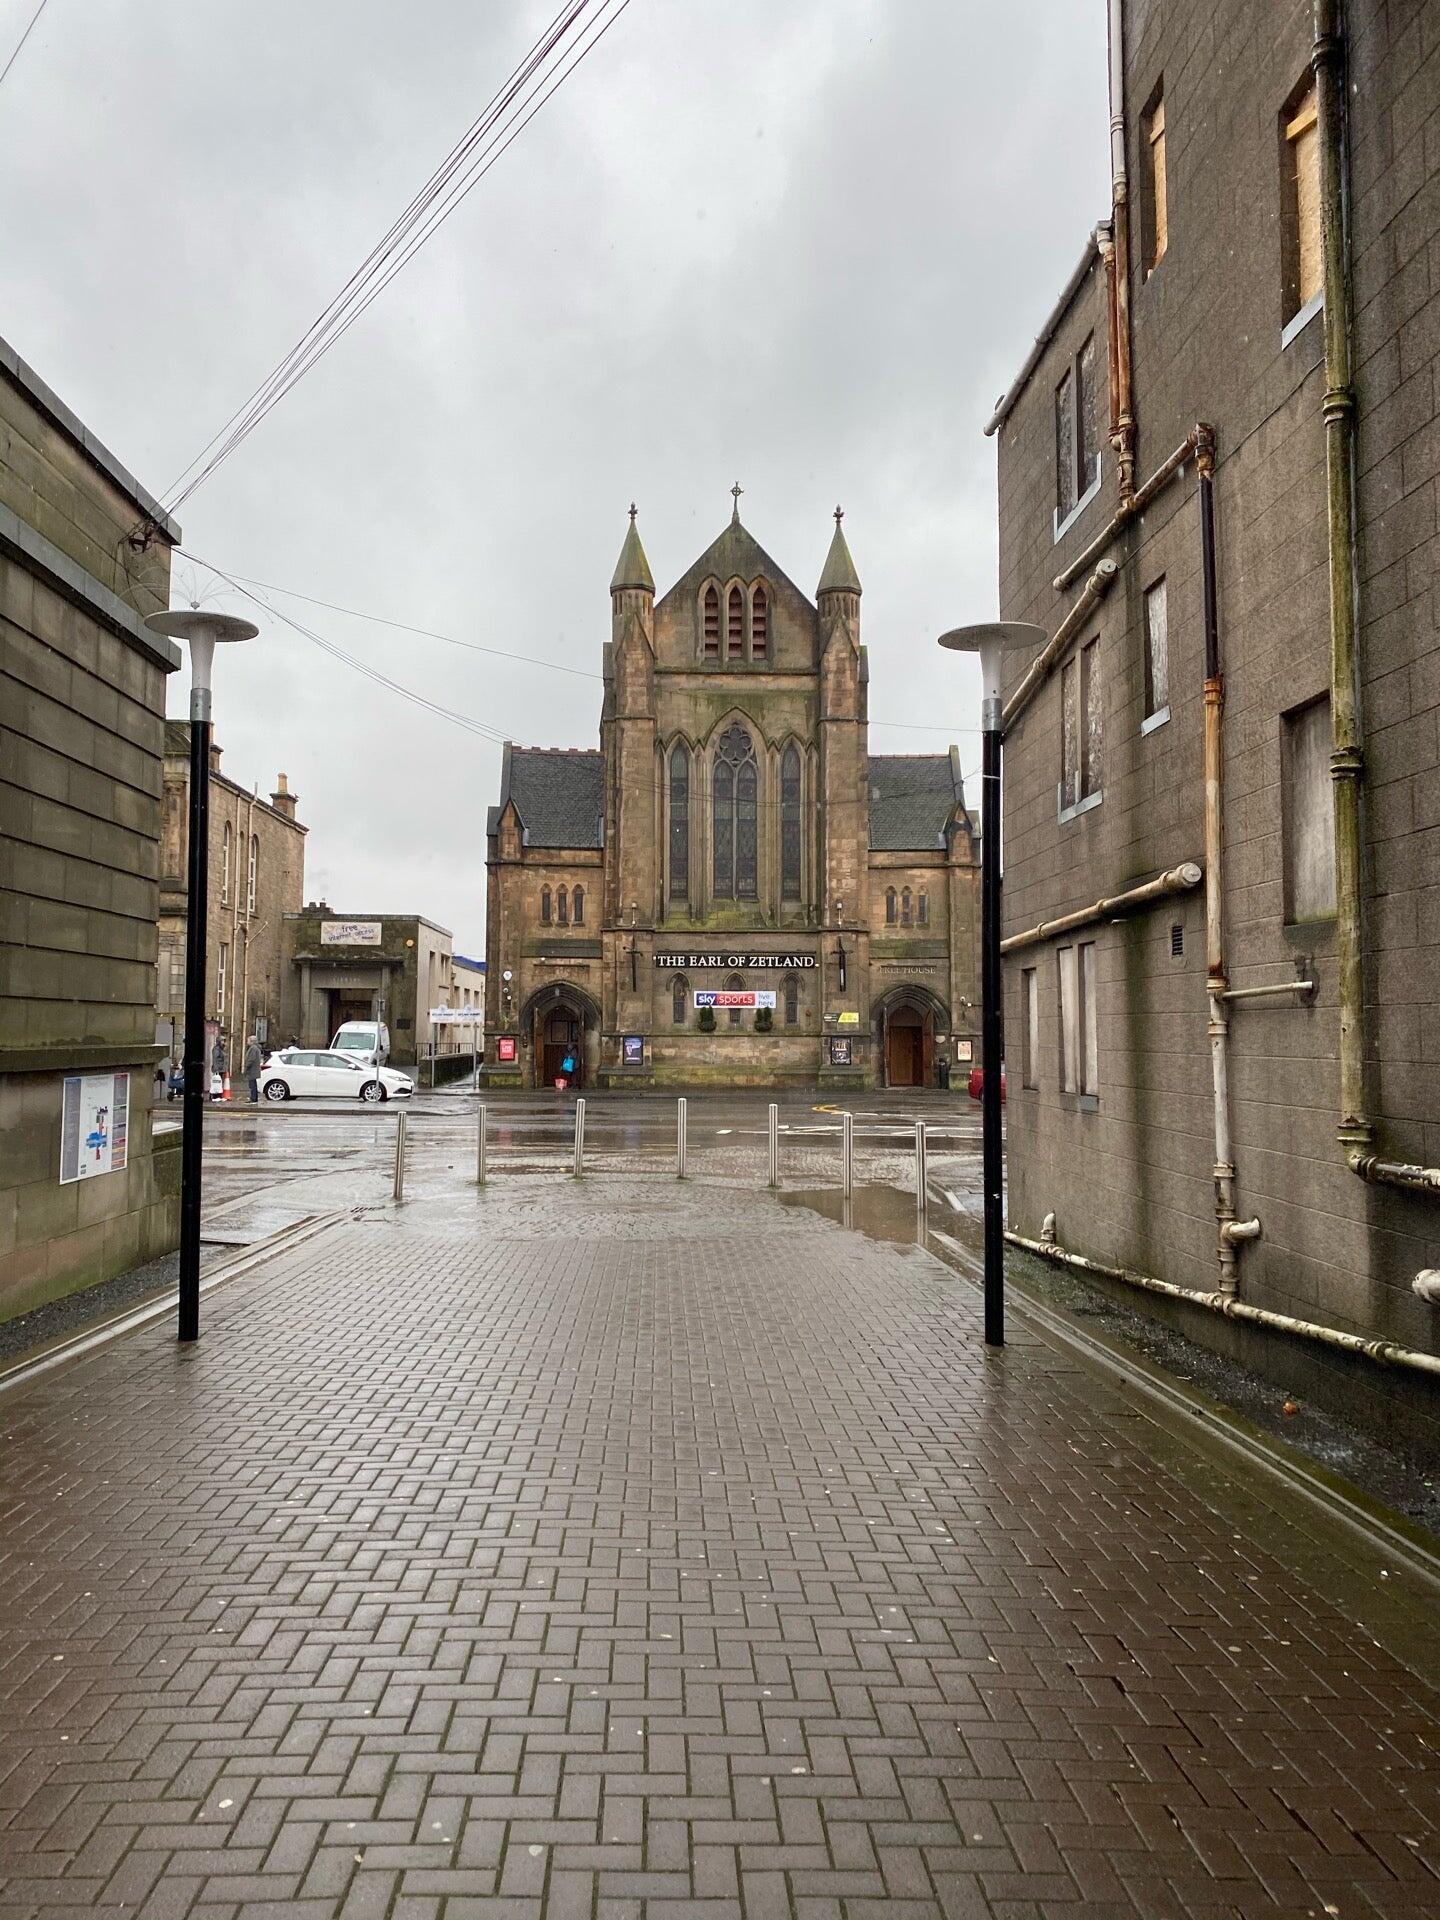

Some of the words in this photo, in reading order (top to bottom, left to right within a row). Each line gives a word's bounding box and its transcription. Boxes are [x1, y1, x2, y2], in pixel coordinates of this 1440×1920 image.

[329, 932, 351, 941] internet
[657, 956, 685, 967] THE
[689, 956, 725, 967] EARL
[728, 956, 746, 967] OF
[749, 956, 814, 968] ZETLAND
[698, 994, 716, 1005] sky
[718, 995, 753, 1005] sports
